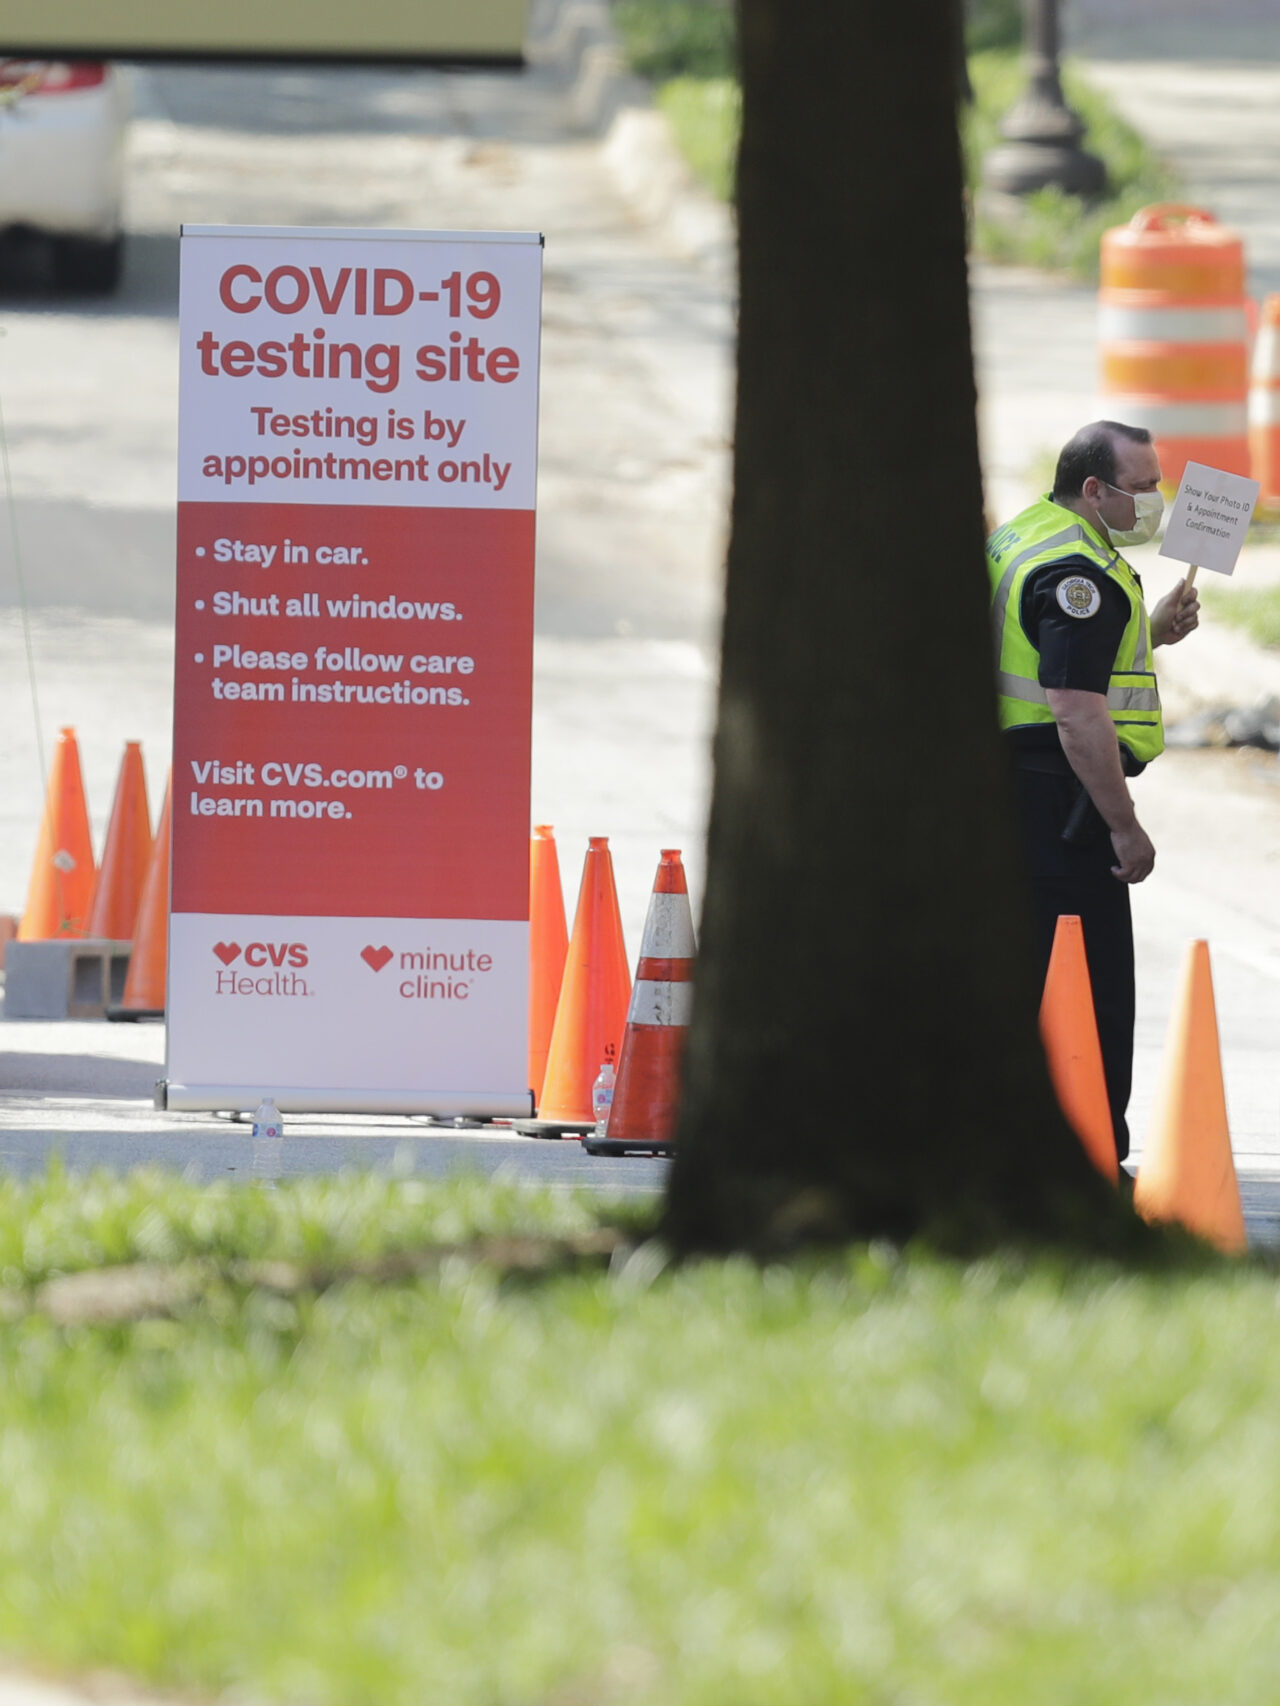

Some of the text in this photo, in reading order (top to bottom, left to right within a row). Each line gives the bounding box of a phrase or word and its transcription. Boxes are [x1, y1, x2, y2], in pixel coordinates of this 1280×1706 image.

[219, 264, 502, 319] COVID-19
[197, 328, 520, 393] testing site
[250, 406, 466, 448] Testing is by
[202, 448, 512, 491] appointment only
[1184, 484, 1250, 512] Show Your Photo ID
[1185, 518, 1231, 539] Confirmation
[1194, 504, 1238, 526] Appointment
[213, 538, 369, 568] Stay in car.
[212, 591, 463, 621] Shut all windows.
[1066, 605, 1090, 616] POLICE
[213, 644, 475, 675] Please follow care
[211, 677, 470, 706] team instructions.
[191, 760, 255, 785] Visit
[414, 767, 444, 790] to
[190, 791, 353, 819] learn more.
[244, 942, 309, 968] CVS
[400, 946, 492, 972] minute
[215, 970, 309, 996] Health
[399, 974, 470, 1001] clinic
